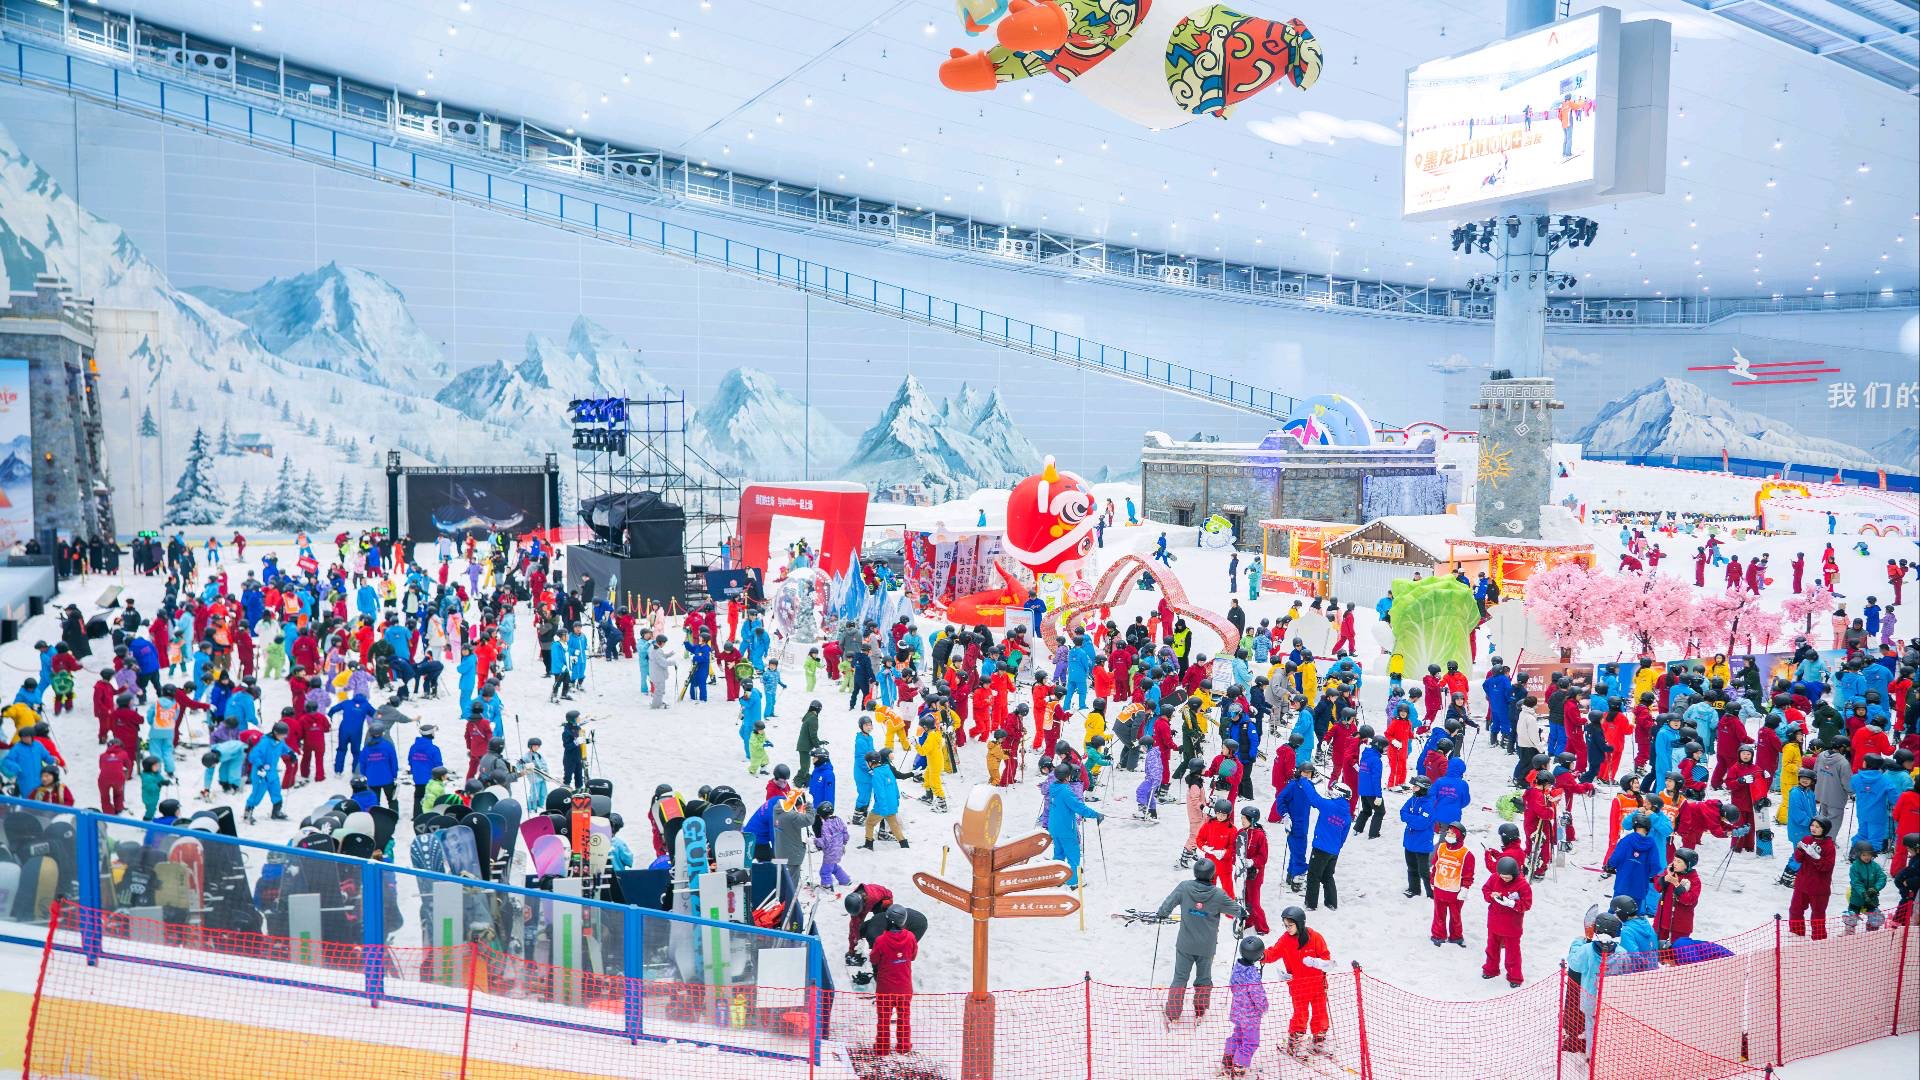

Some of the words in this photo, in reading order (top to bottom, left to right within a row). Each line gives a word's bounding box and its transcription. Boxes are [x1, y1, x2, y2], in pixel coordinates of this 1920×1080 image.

[1827, 381, 1920, 409] 我们的
[1439, 863, 1457, 878] 167
